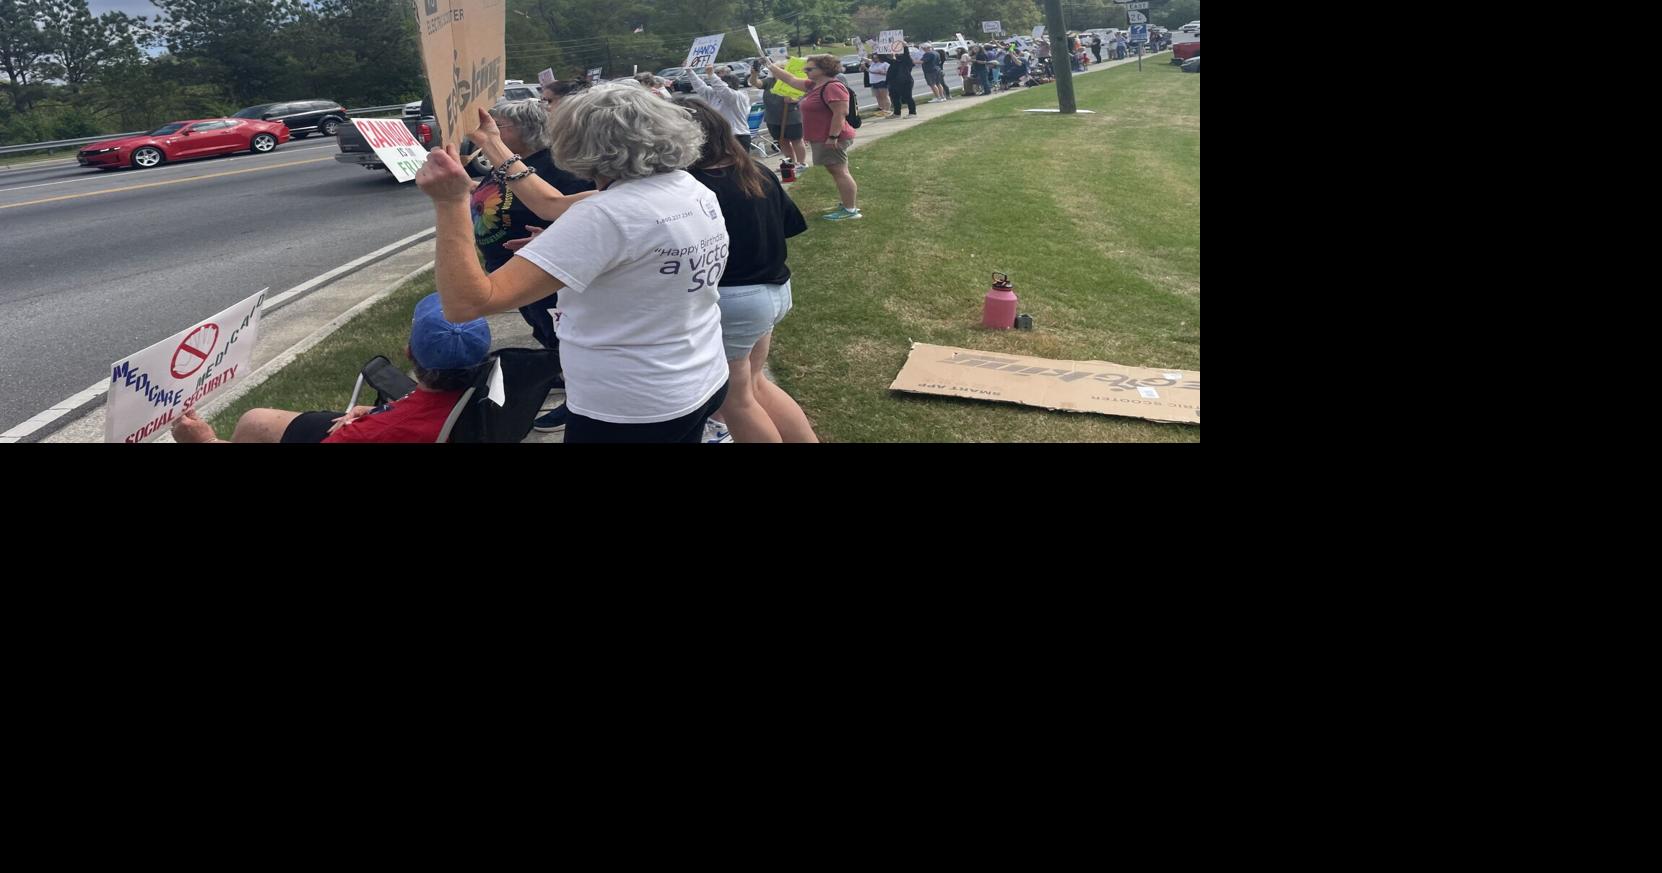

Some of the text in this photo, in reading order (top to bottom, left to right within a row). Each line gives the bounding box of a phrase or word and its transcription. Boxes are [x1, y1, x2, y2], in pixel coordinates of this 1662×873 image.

[693, 43, 718, 56] HANDS
[356, 120, 420, 148] CANADA
[396, 147, 408, 157] IS
[397, 159, 422, 176] FRI
[659, 243, 728, 275] a victo
[195, 293, 265, 390] MEDICAID
[112, 360, 184, 407] MEDICARE
[182, 364, 238, 412] SECURITY
[949, 386, 1001, 396] SMART
[1090, 395, 1162, 406] SCOOTER
[124, 409, 175, 443] SOCIAL
